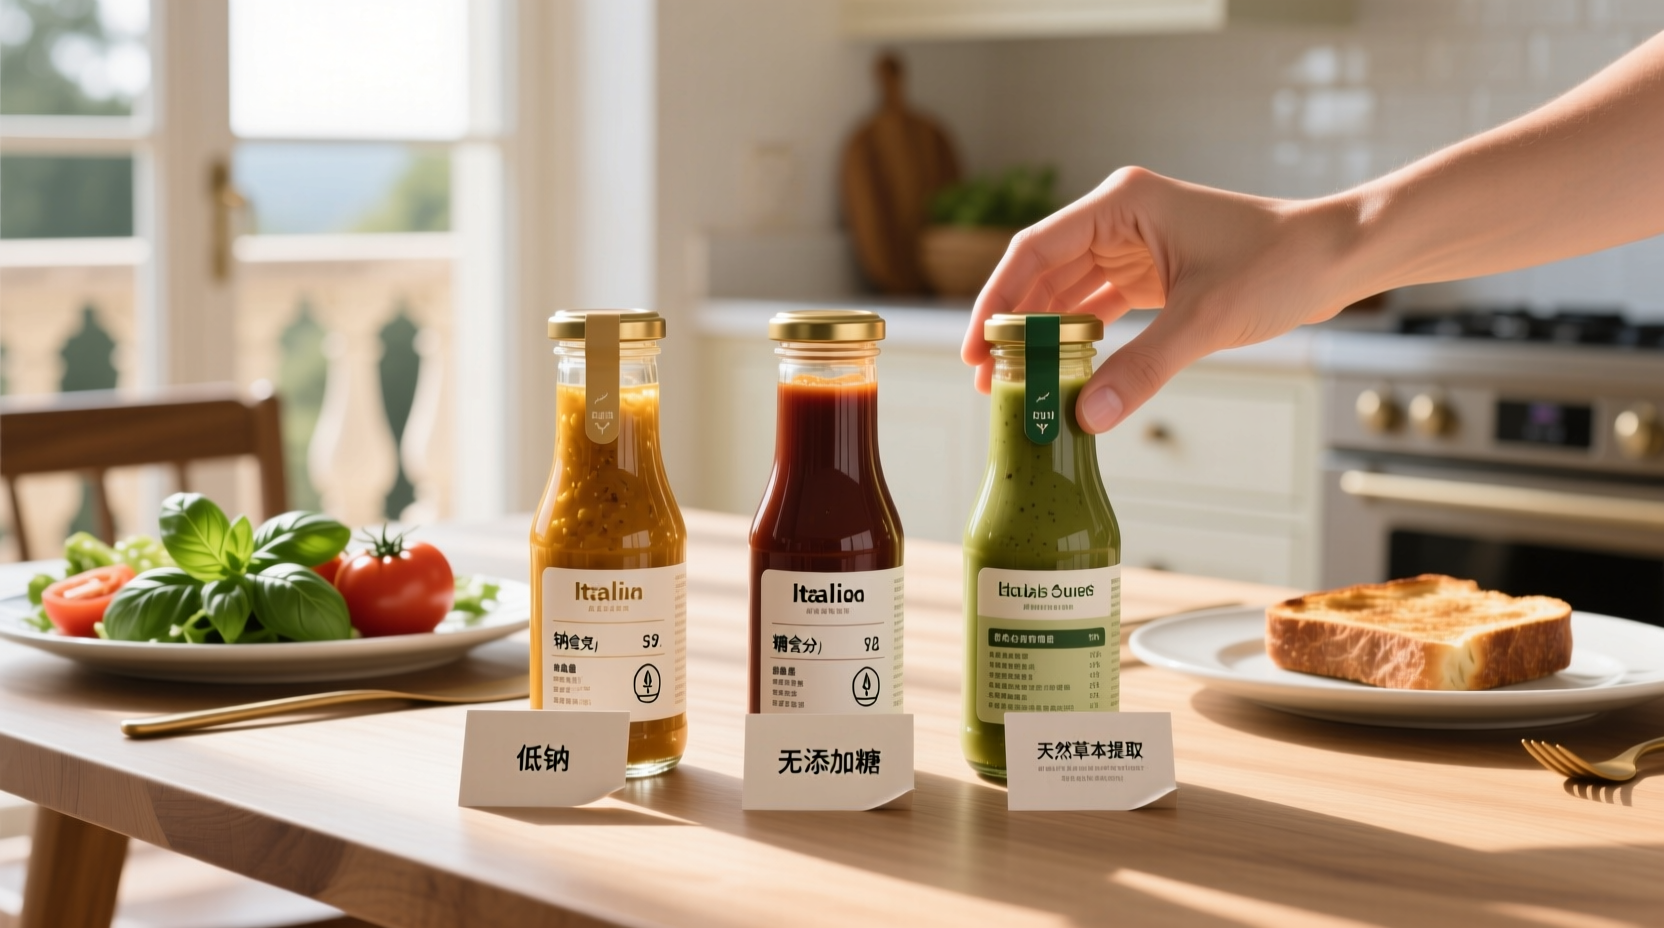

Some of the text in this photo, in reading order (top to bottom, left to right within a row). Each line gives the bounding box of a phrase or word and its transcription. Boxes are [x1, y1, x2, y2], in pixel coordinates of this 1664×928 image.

[516, 744, 569, 772] 低钠
[778, 748, 881, 774] 无添加糖
[1037, 741, 1143, 760] 天然草本提取
